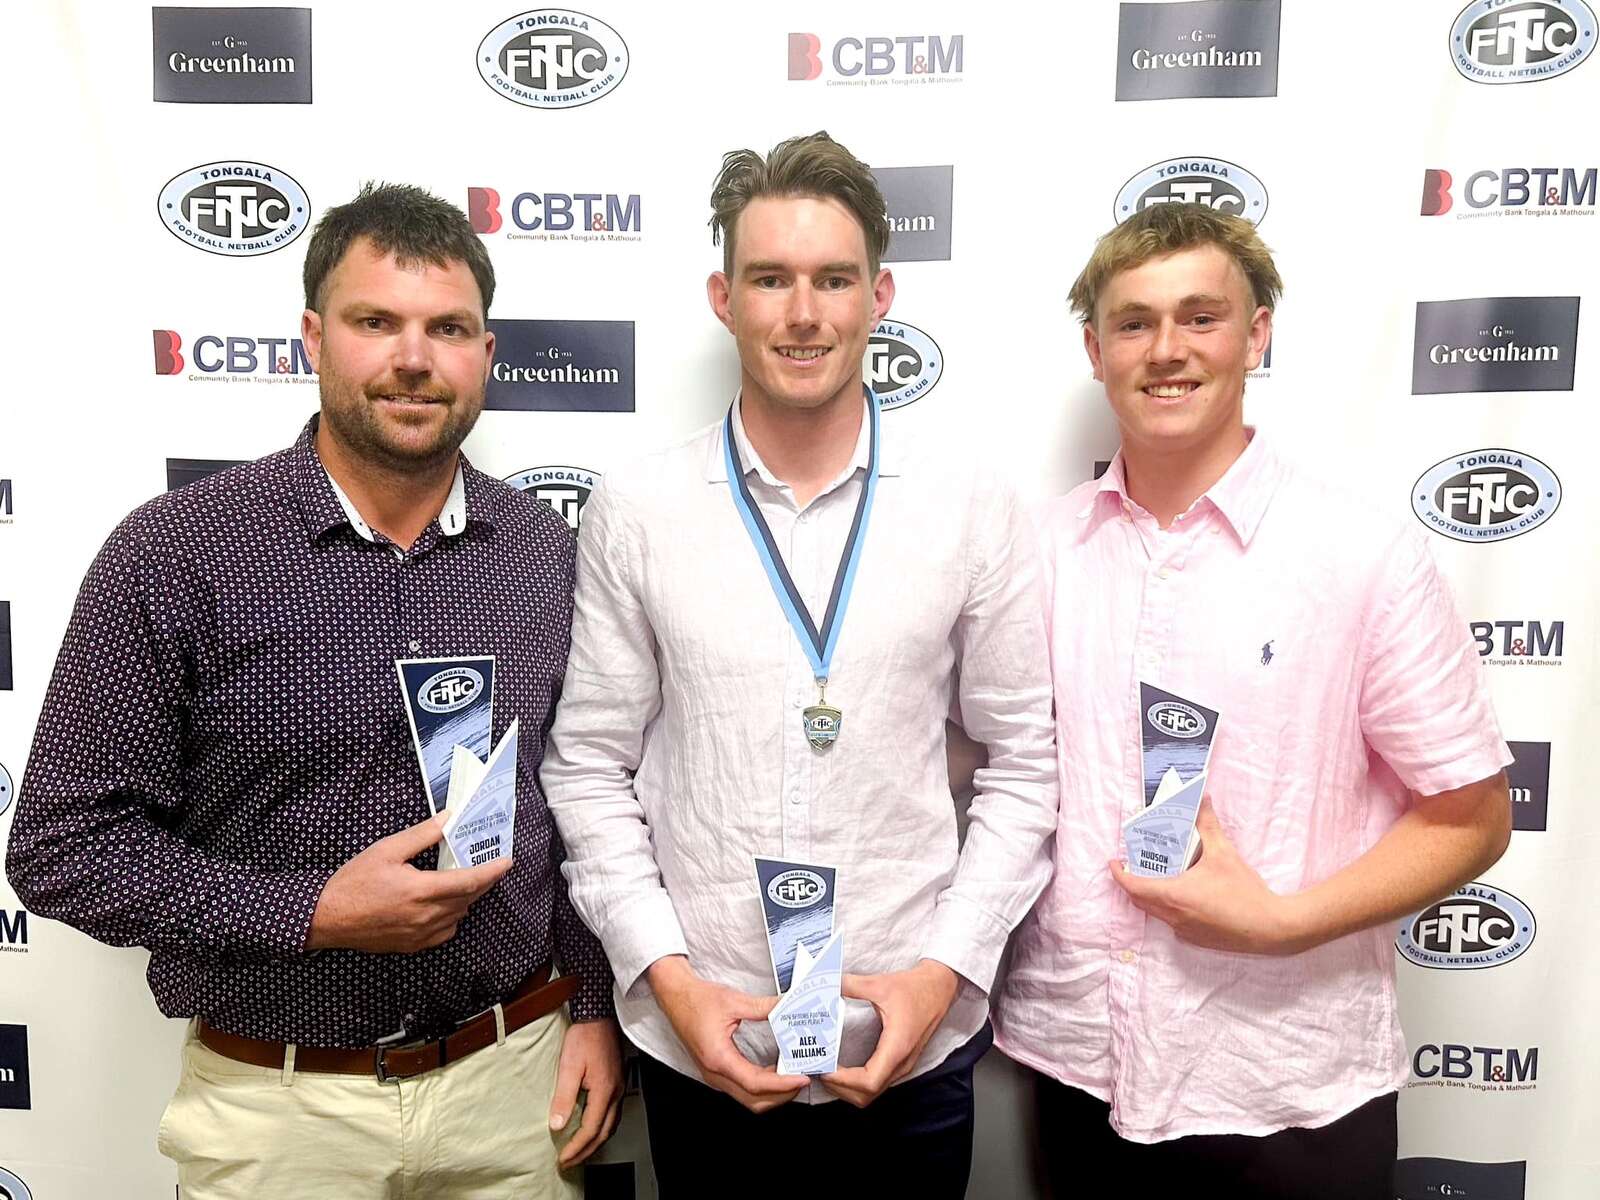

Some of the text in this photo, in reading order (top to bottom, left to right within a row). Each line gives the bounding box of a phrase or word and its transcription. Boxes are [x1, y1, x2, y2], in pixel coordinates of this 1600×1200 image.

[516, 15, 589, 30] TONGALA
[169, 52, 295, 73] Greenham
[1132, 46, 1261, 70] Greenham
[1458, 48, 1582, 77] FOOTBALL NETBALL CLUB
[491, 74, 615, 102] FOOTBALL NETBALL CLUB
[200, 167, 272, 182] TONGALA
[1156, 163, 1228, 177] TONGALA
[1524, 209, 1551, 217] Tongala
[173, 219, 297, 250] FOOTBALL NETBALL CLUB
[506, 233, 548, 241] Community
[1429, 341, 1559, 364] Greenham
[188, 374, 230, 384] Community
[492, 362, 619, 383] Greenham
[905, 378, 929, 398] CLUB
[1456, 454, 1522, 469] TONGALA
[522, 472, 593, 486] TONGALA
[1426, 508, 1545, 536] FOOTBALL NETBALL CLUB
[1469, 620, 1564, 656] BT&M
[470, 834, 500, 855] JORDAN
[471, 848, 500, 867] SOUTER
[1141, 849, 1168, 864] HUDSON
[1140, 859, 1167, 874] KELLETT
[1456, 887, 1497, 902] GALA
[1405, 942, 1521, 964] FOOTBALL NETBALL CLUB
[799, 1036, 817, 1046] ALEX
[791, 1047, 827, 1059] WILLIAMS
[1407, 1080, 1445, 1088] Community
[1446, 1080, 1465, 1088] Bank
[1468, 1082, 1497, 1091] Tongala
